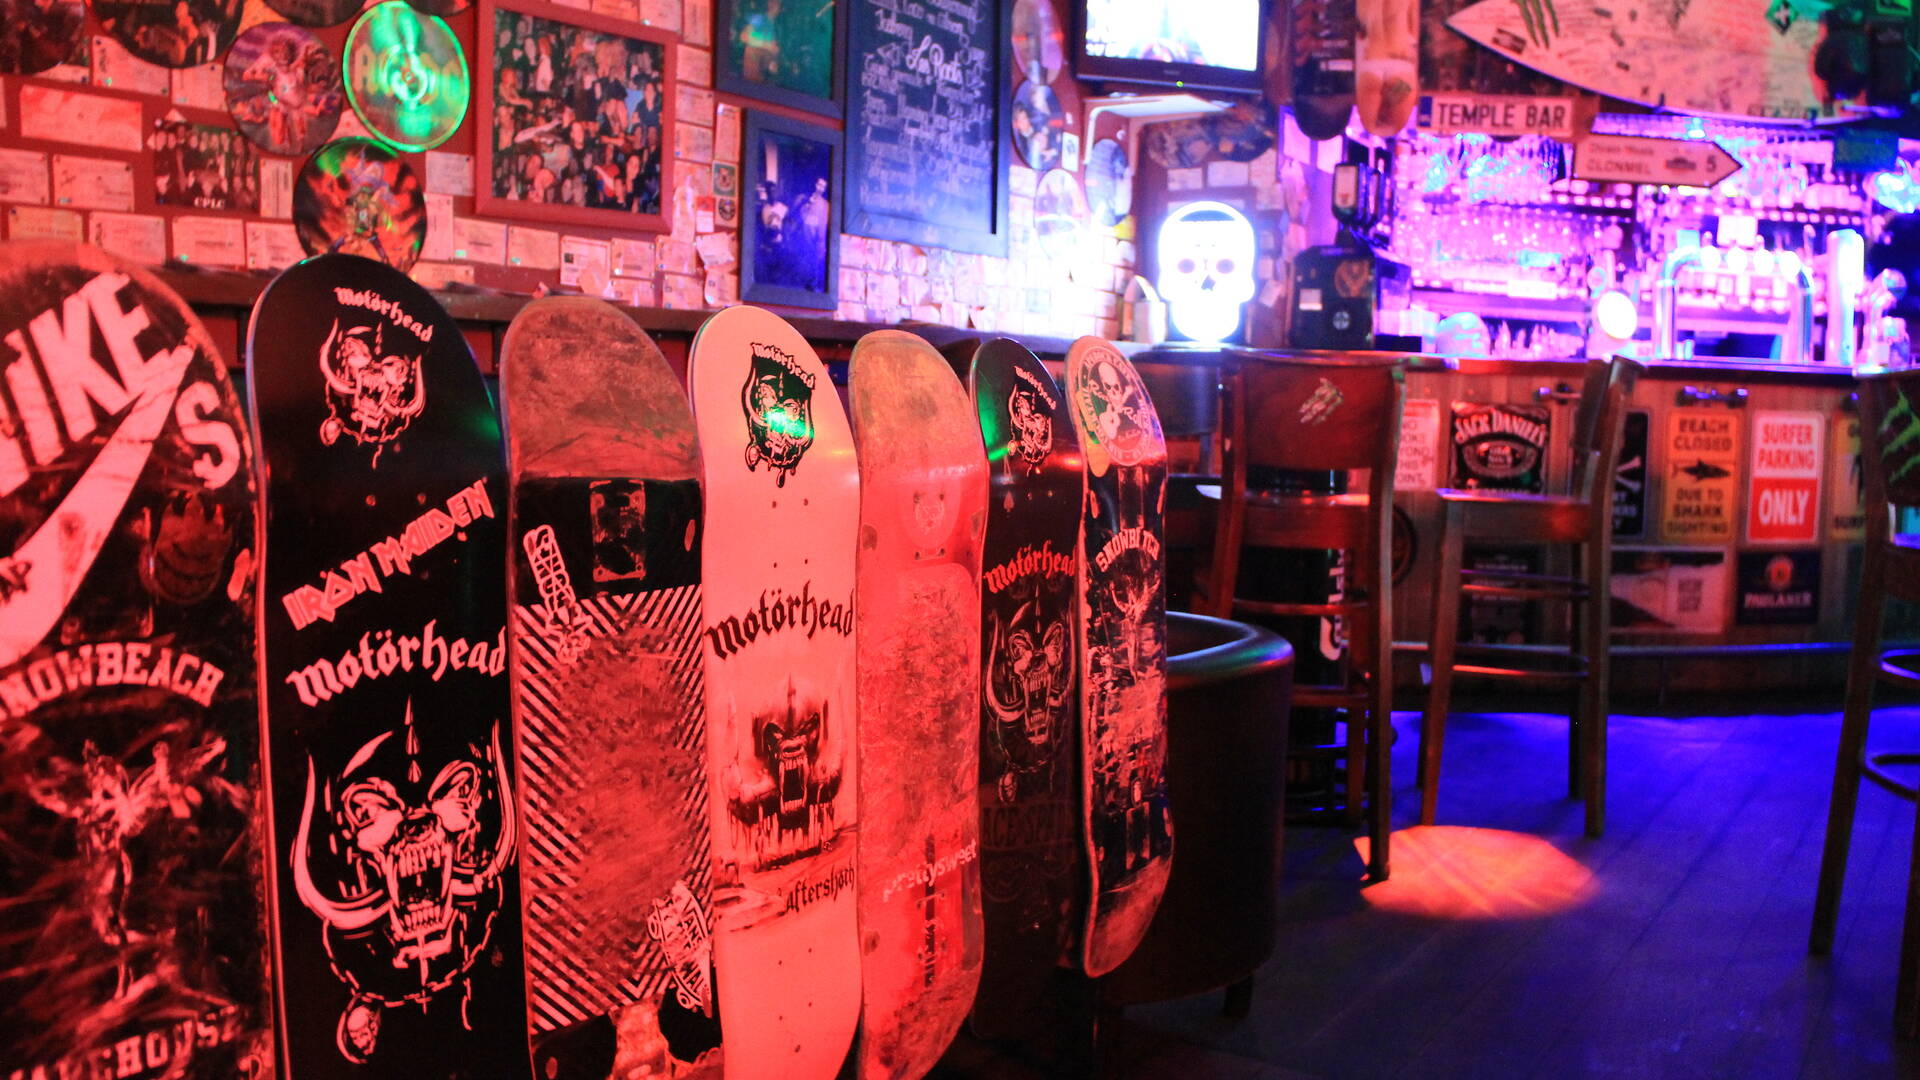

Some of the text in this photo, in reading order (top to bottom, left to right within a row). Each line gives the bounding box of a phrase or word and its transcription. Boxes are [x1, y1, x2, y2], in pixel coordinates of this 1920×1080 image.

[1437, 102, 1566, 130] TEMPLE BAR
[1587, 155, 1717, 174] CLONMEL 5
[1455, 408, 1546, 448] JACK DANIEL'S
[1679, 418, 1729, 433] BEACH
[1762, 424, 1813, 445] SURFER
[1673, 436, 1733, 450] CLOSED
[1758, 448, 1815, 470] PARKING
[1677, 488, 1724, 501] DUE TO
[1674, 505, 1723, 517] SHARK
[1758, 489, 1810, 526] ONLY
[1667, 521, 1728, 534] SIGHTING
[282, 551, 382, 630] IRON
[370, 479, 495, 577] MAIDEN
